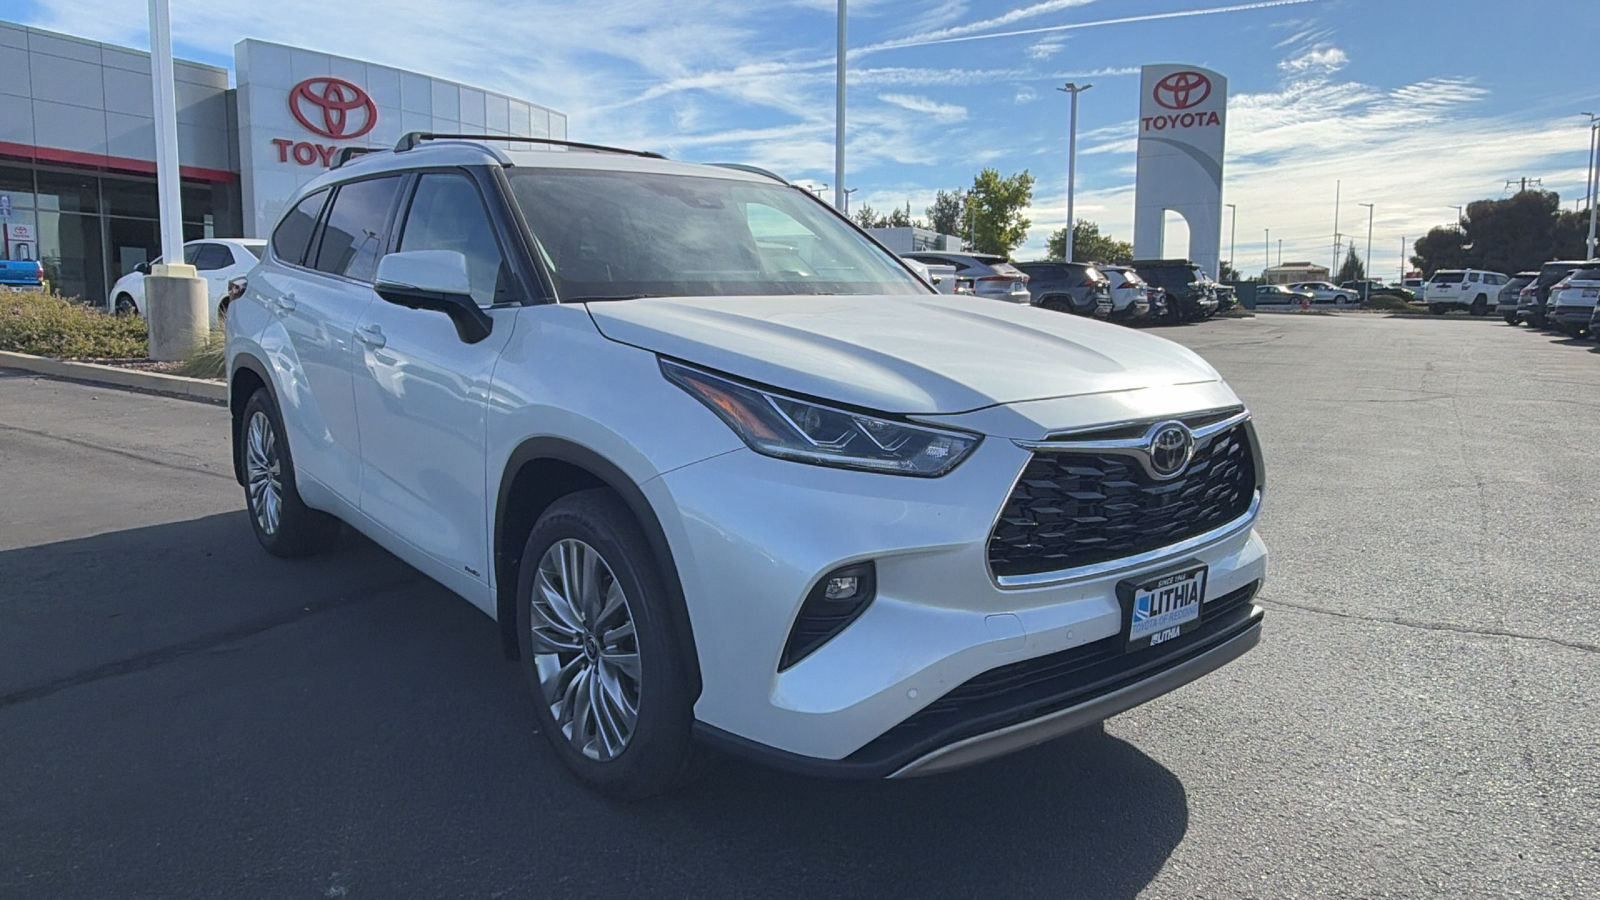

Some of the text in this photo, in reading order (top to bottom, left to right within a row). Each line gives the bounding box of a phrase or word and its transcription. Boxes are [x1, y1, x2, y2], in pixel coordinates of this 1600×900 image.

[1142, 111, 1220, 131] TOYOTA
[272, 138, 338, 168] TOY
[1149, 581, 1198, 617] LITHIA
[1132, 619, 1157, 633] TOYOTA
[1160, 615, 1168, 625] OF
[1157, 625, 1180, 644] LITHIA
